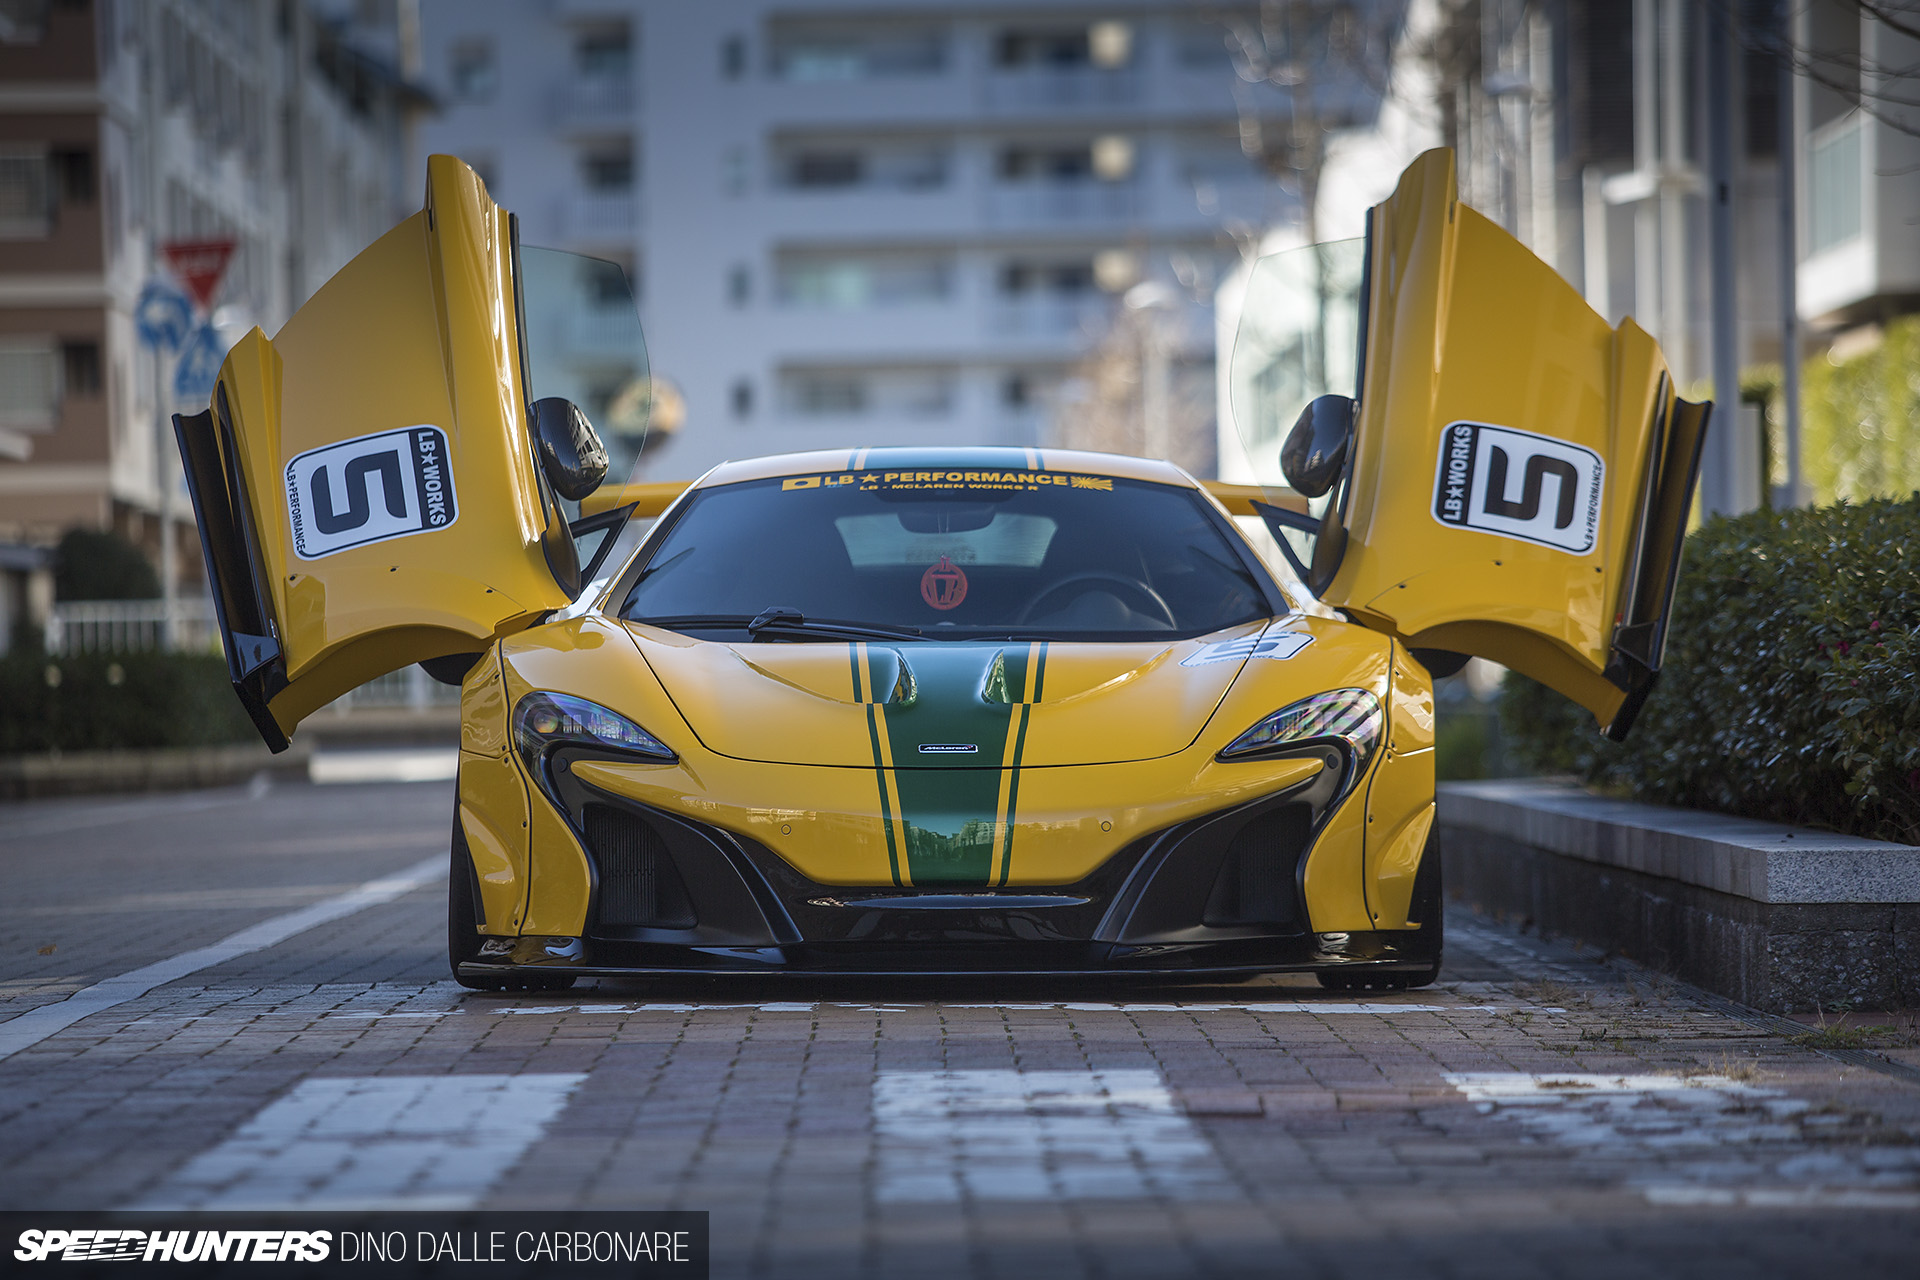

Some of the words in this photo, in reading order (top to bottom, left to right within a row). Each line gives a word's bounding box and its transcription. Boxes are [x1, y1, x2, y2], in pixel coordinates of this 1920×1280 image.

[417, 431, 436, 453] LB
[1448, 425, 1473, 487] WORKS
[310, 449, 408, 535] 5
[422, 464, 447, 526] WORKS
[824, 475, 855, 486] LB
[884, 472, 1068, 486] PERFORMANCE
[1442, 499, 1463, 521] LB
[1482, 445, 1578, 530] 5
[1586, 464, 1603, 528] PERFORMANCE
[288, 487, 306, 551] PERFORMANCE
